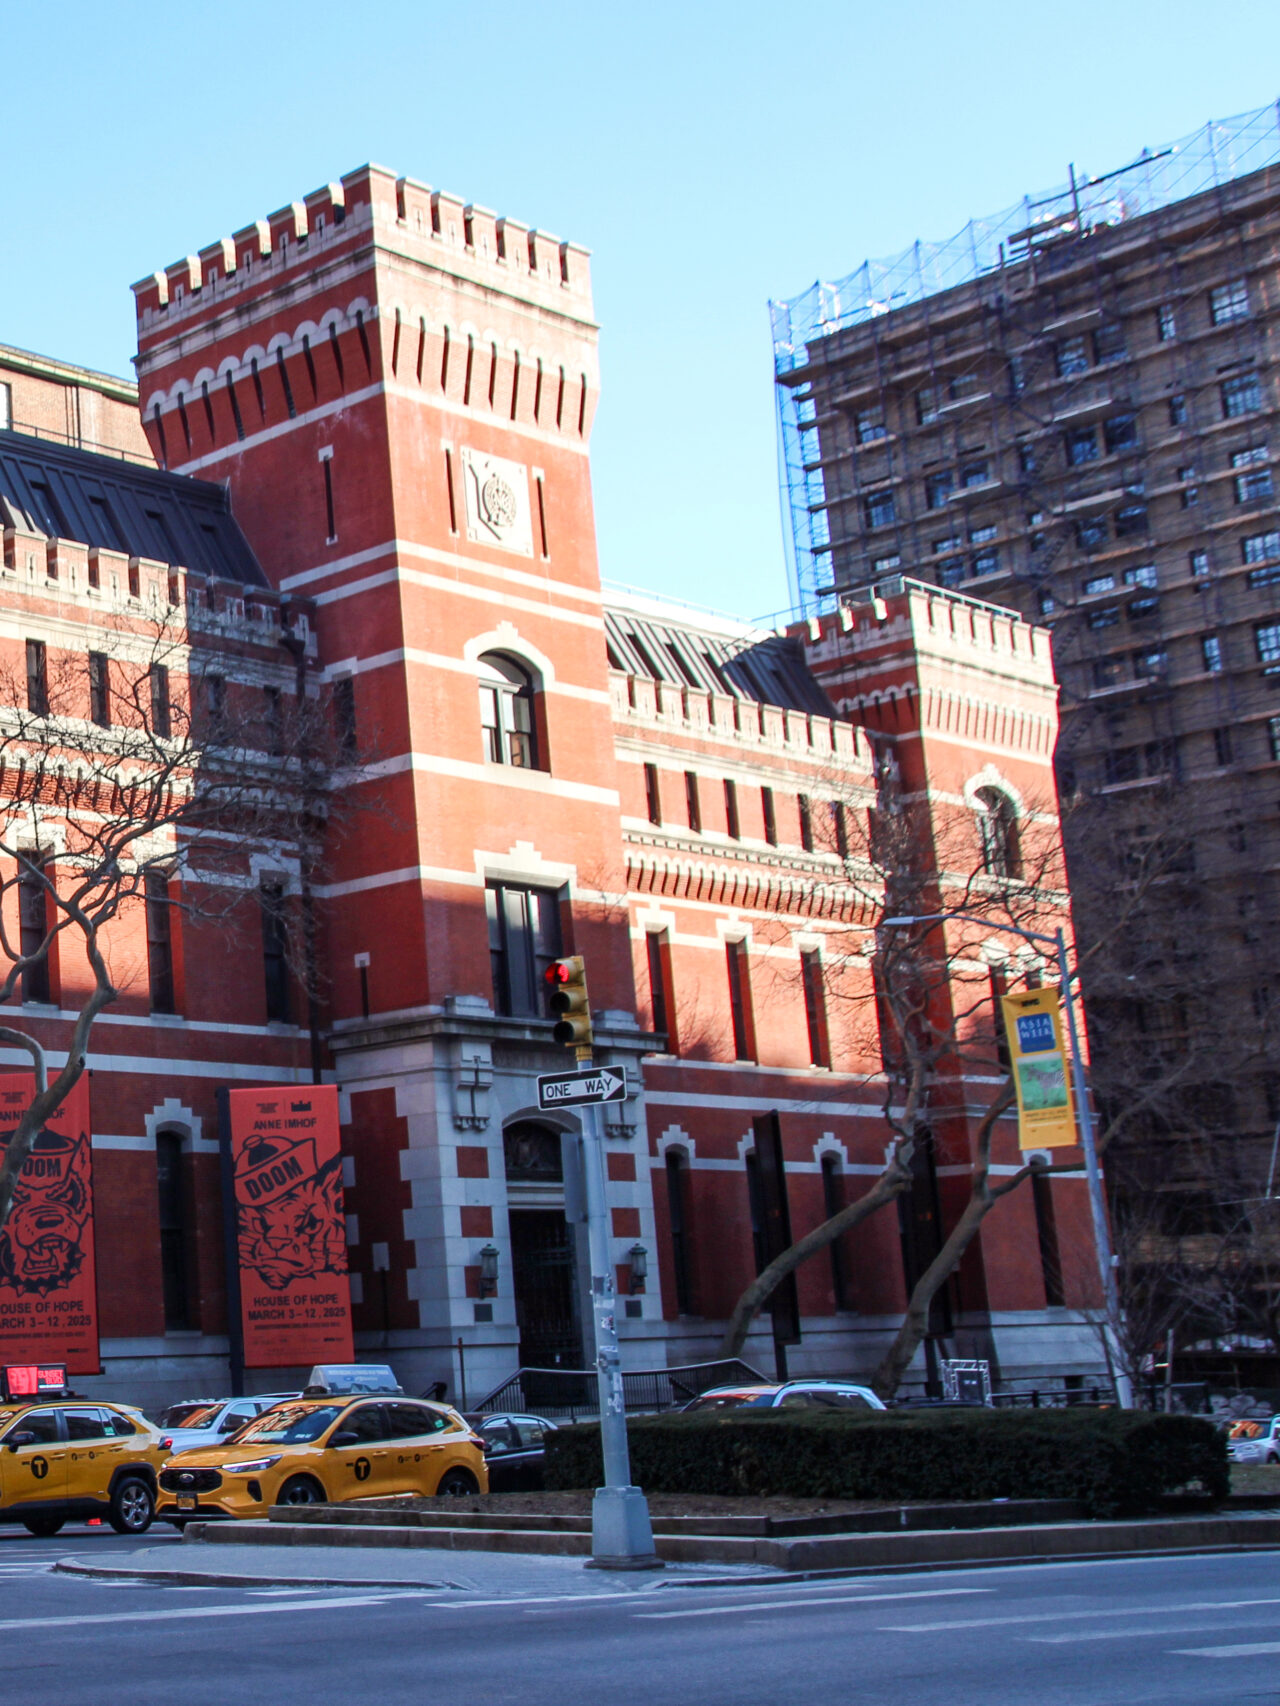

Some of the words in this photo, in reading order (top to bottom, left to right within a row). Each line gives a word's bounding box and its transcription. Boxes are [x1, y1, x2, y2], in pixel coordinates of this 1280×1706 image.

[546, 1083, 571, 1098] ONE
[585, 1078, 613, 1093] WAY
[254, 1120, 281, 1129] ANNE
[285, 1118, 316, 1128] IMHOF
[23, 1158, 62, 1177] OOM
[244, 1156, 304, 1200] DOOM
[255, 1296, 290, 1306] HOUSE
[294, 1296, 308, 1305] OF
[311, 1295, 338, 1304] HOPE
[36, 1303, 50, 1312] OF
[55, 1301, 83, 1311] HOPE
[249, 1311, 284, 1320] MARCH
[324, 1308, 345, 1317] 2025
[68, 1316, 91, 1326] 2025
